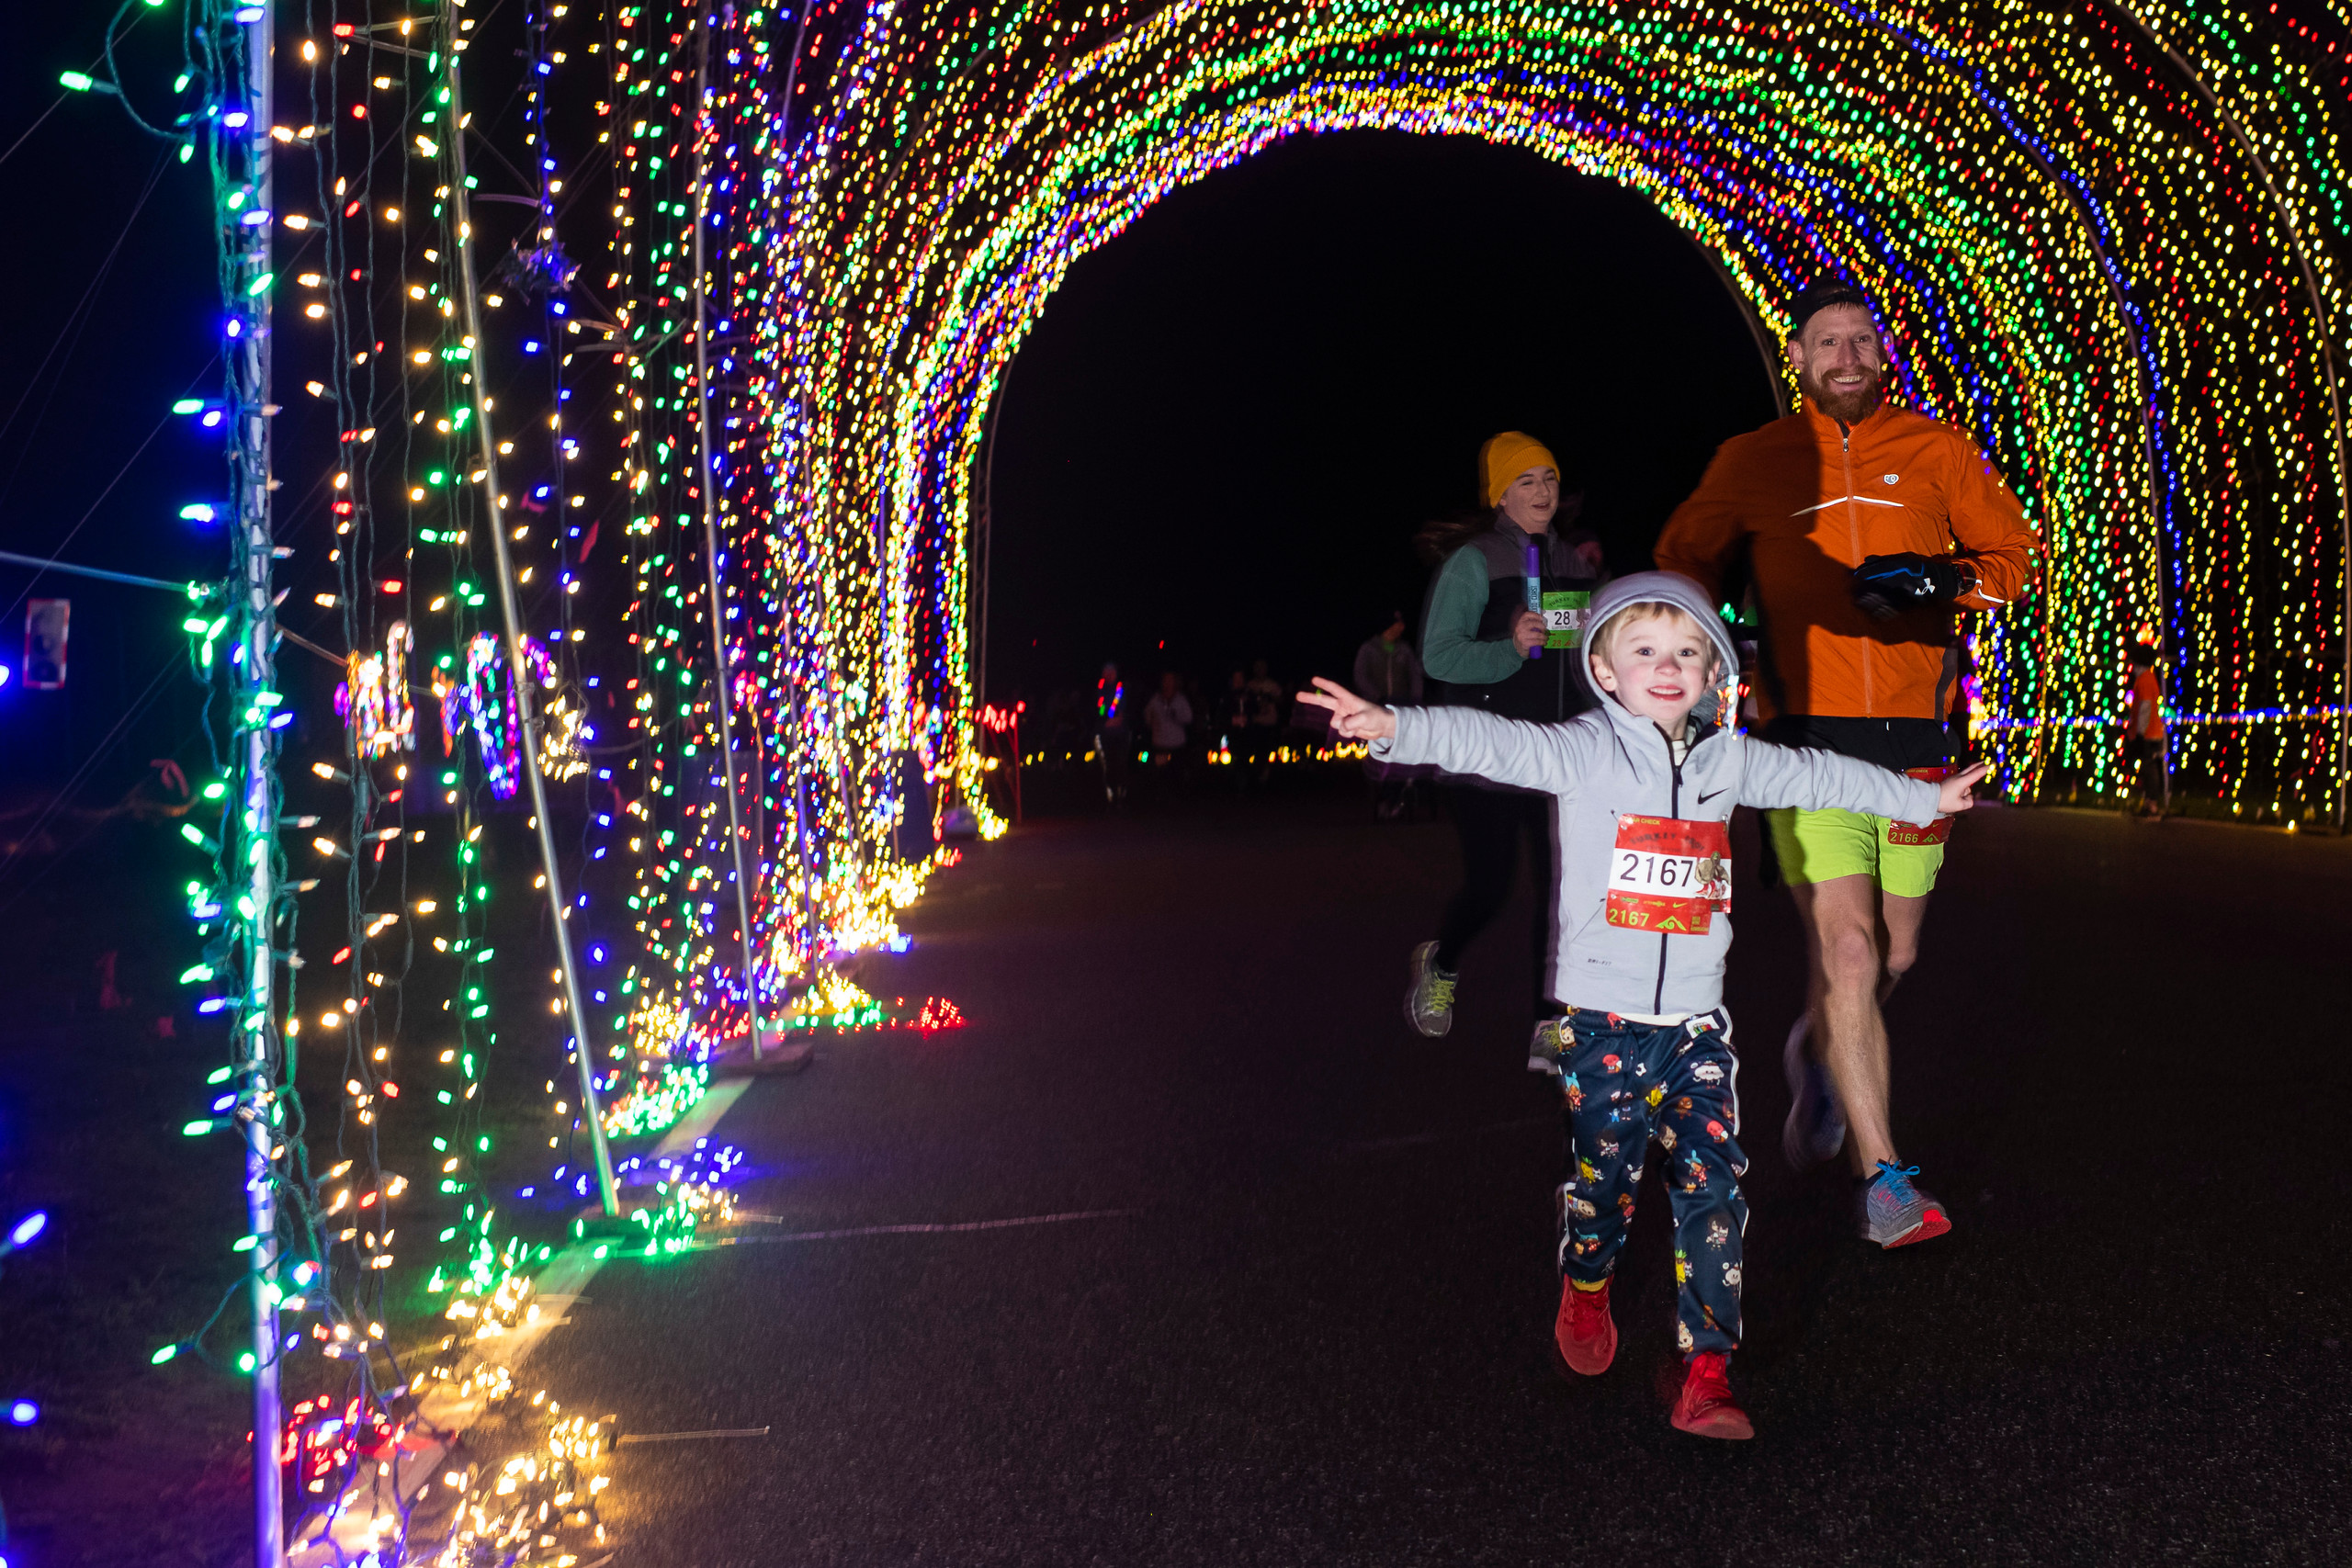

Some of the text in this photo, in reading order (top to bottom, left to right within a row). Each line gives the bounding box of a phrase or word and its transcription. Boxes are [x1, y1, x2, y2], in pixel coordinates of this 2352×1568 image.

[1555, 611, 1570, 626] 28
[1890, 832, 1918, 842] 2166
[1620, 853, 1694, 887] 2167
[1609, 908, 1650, 927] 2167
